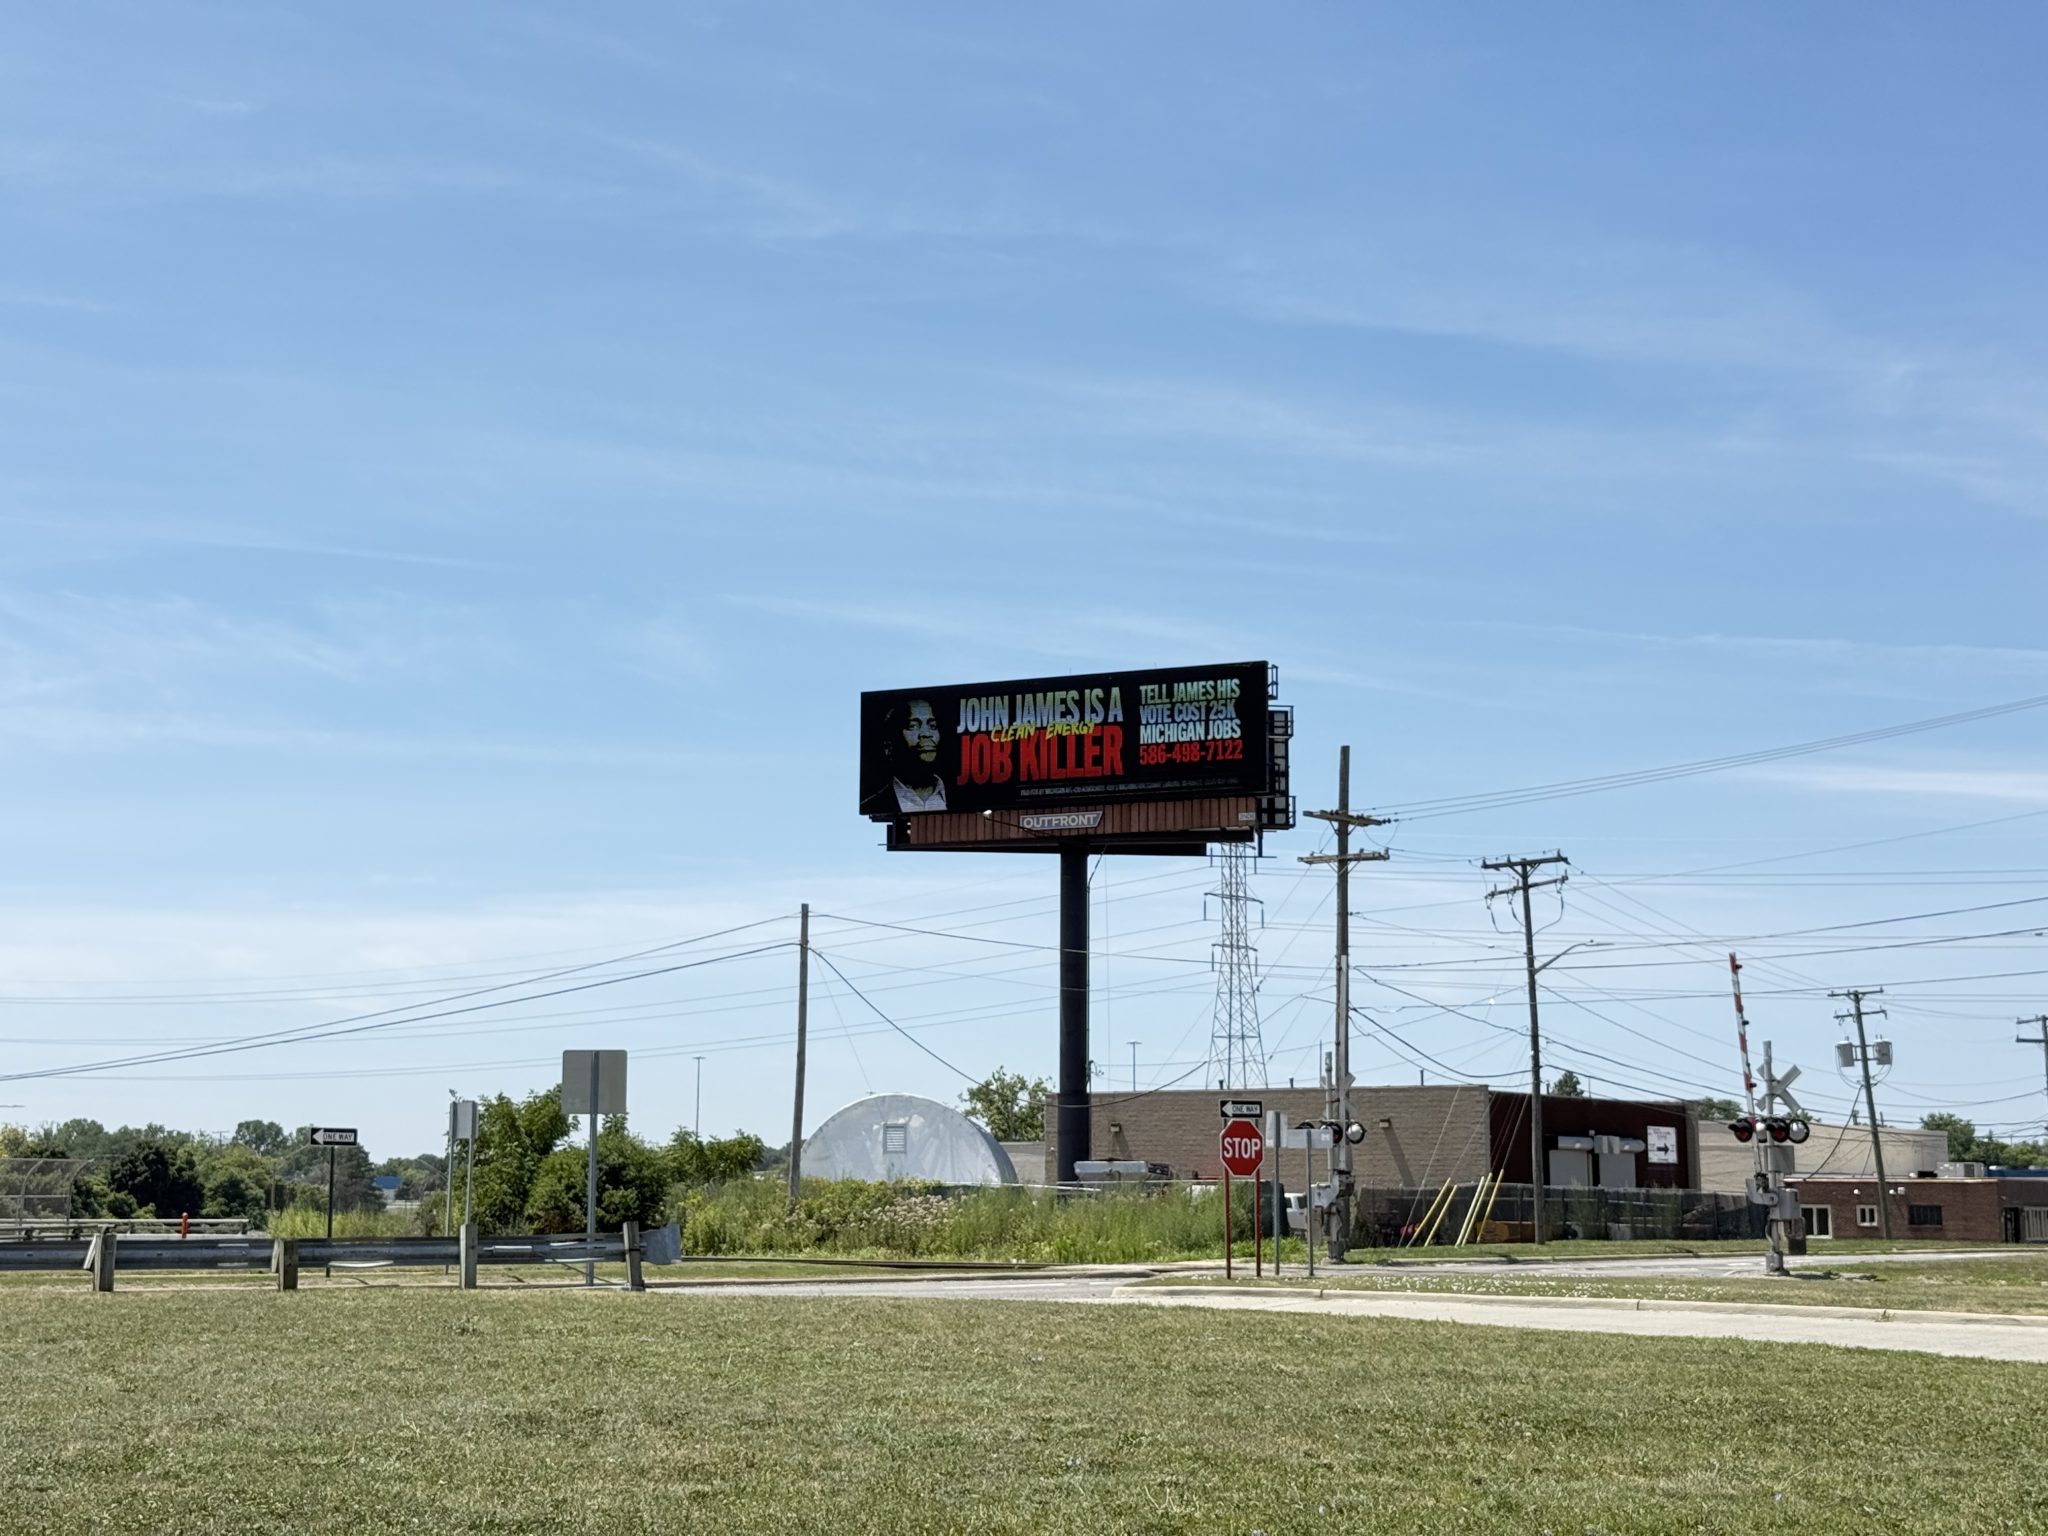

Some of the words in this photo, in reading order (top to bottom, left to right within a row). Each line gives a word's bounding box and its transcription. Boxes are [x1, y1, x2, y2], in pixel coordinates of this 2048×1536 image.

[1139, 684, 1170, 705] TELL
[1172, 680, 1215, 702] JAMES
[1217, 678, 1241, 699] HIS
[957, 695, 1009, 733] JOHN
[1015, 689, 1080, 727] JAMES
[1084, 687, 1105, 724] IS
[1107, 686, 1124, 723] A
[1139, 703, 1172, 724] VOTE
[1174, 700, 1207, 722] COST
[1209, 699, 1236, 720] 25K
[990, 720, 1036, 743] CLEAN
[1045, 720, 1096, 740] ENERGY
[1139, 721, 1206, 745] MICHIGAN
[1207, 718, 1242, 740] JOBS
[956, 732, 1013, 786] JOB
[1019, 725, 1125, 782] KILLER
[1139, 739, 1243, 765] 586-498-7122
[1023, 813, 1098, 828] OUTFRONT
[1223, 1137, 1261, 1159] STOP
